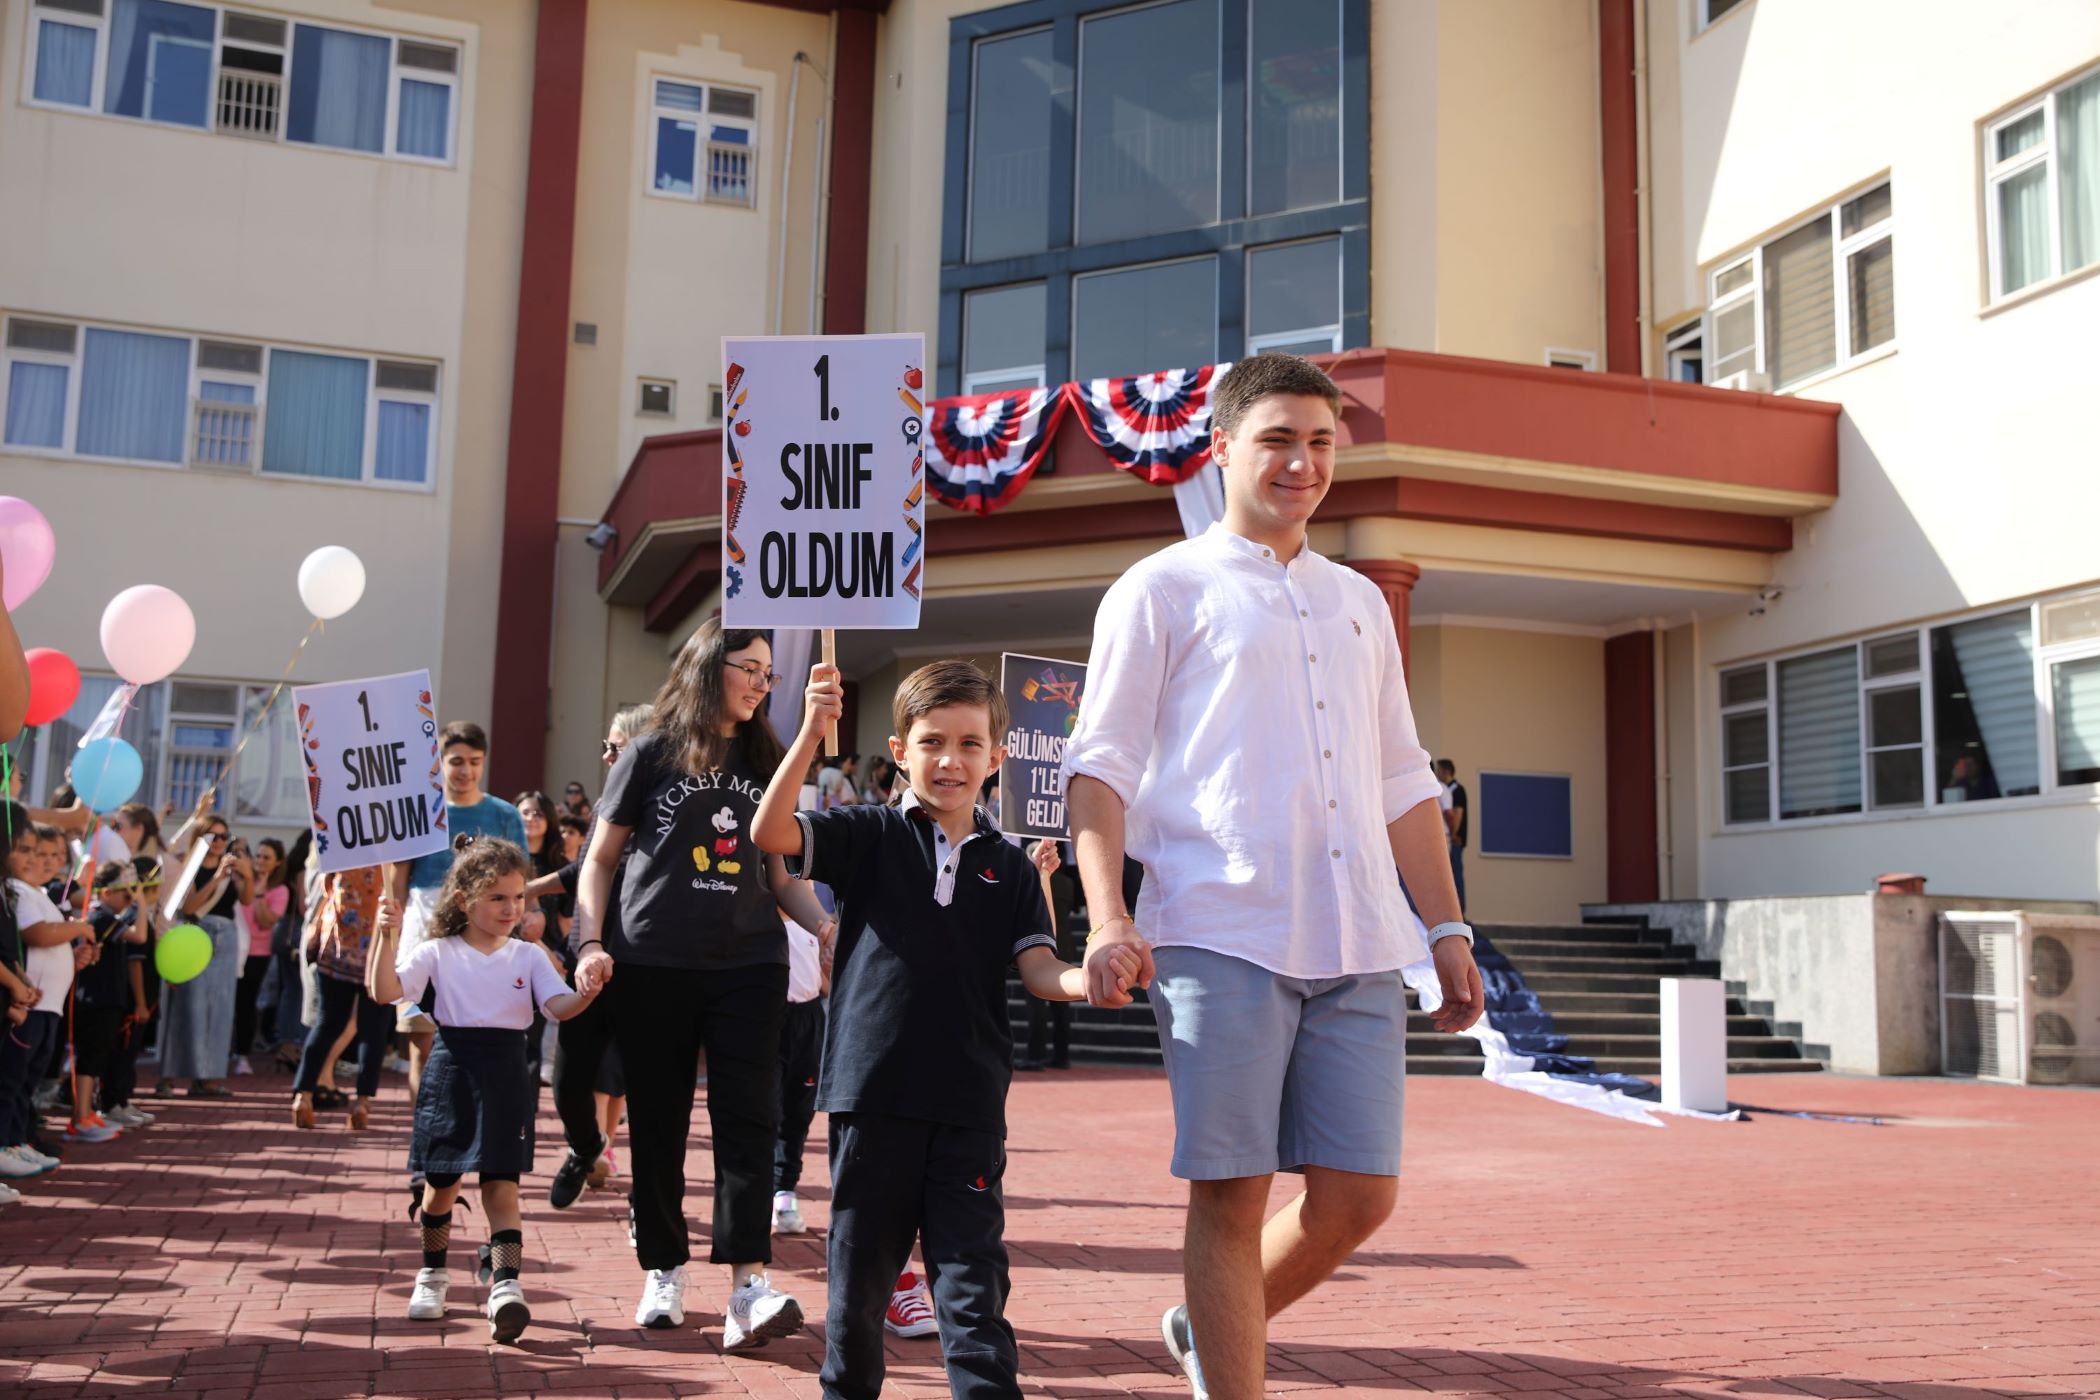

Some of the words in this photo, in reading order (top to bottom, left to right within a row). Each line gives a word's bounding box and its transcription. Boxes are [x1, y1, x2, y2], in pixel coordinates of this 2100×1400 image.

[814, 355, 839, 420] 1.
[780, 443, 873, 510] SINIF
[760, 531, 893, 598] OLDUM
[357, 691, 379, 732] 1.
[342, 742, 407, 791] SINIF
[337, 794, 429, 849] OLDUM
[656, 772, 724, 836] MICKEY
[1026, 798, 1065, 829] GELDİ
